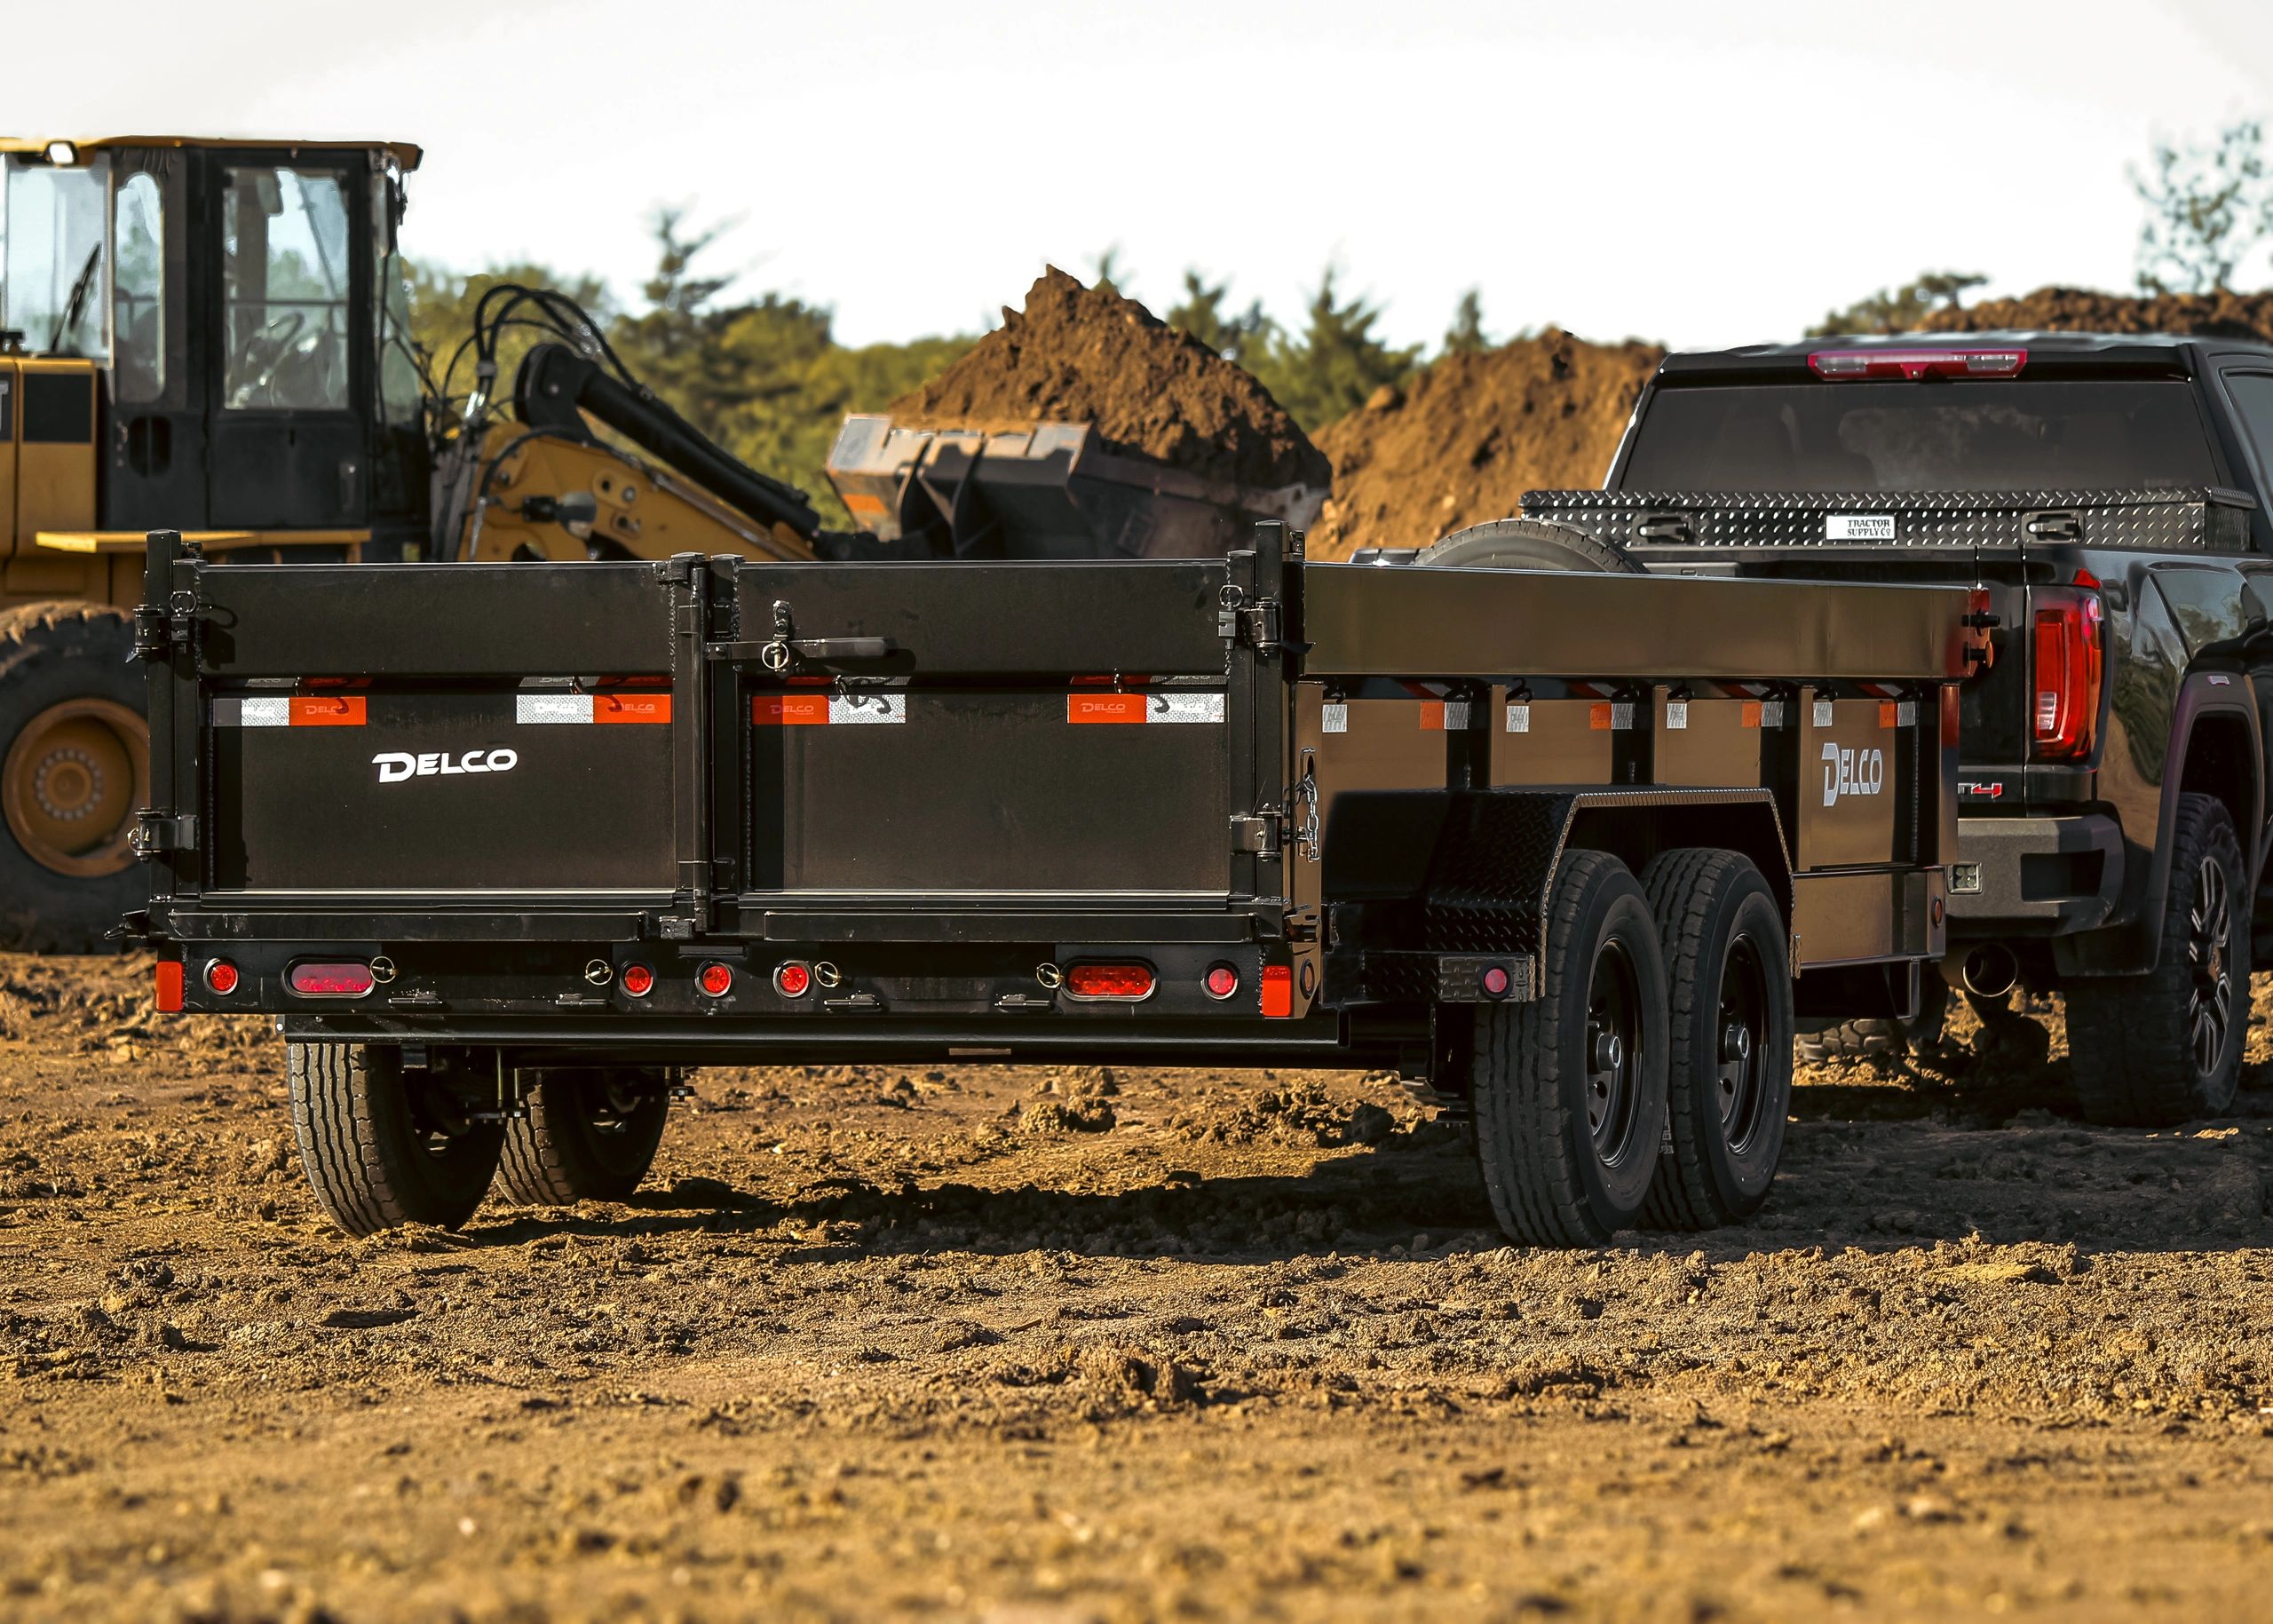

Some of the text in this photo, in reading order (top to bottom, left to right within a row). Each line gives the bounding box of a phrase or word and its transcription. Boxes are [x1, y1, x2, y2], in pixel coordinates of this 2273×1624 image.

[1847, 519, 1890, 527] TRACTOR
[1847, 527, 1879, 536] SUPPLY
[770, 705, 814, 715] DELCO
[1081, 703, 1126, 713] DELCO
[371, 749, 518, 783] DELCO
[1821, 742, 1882, 806] DELCO
